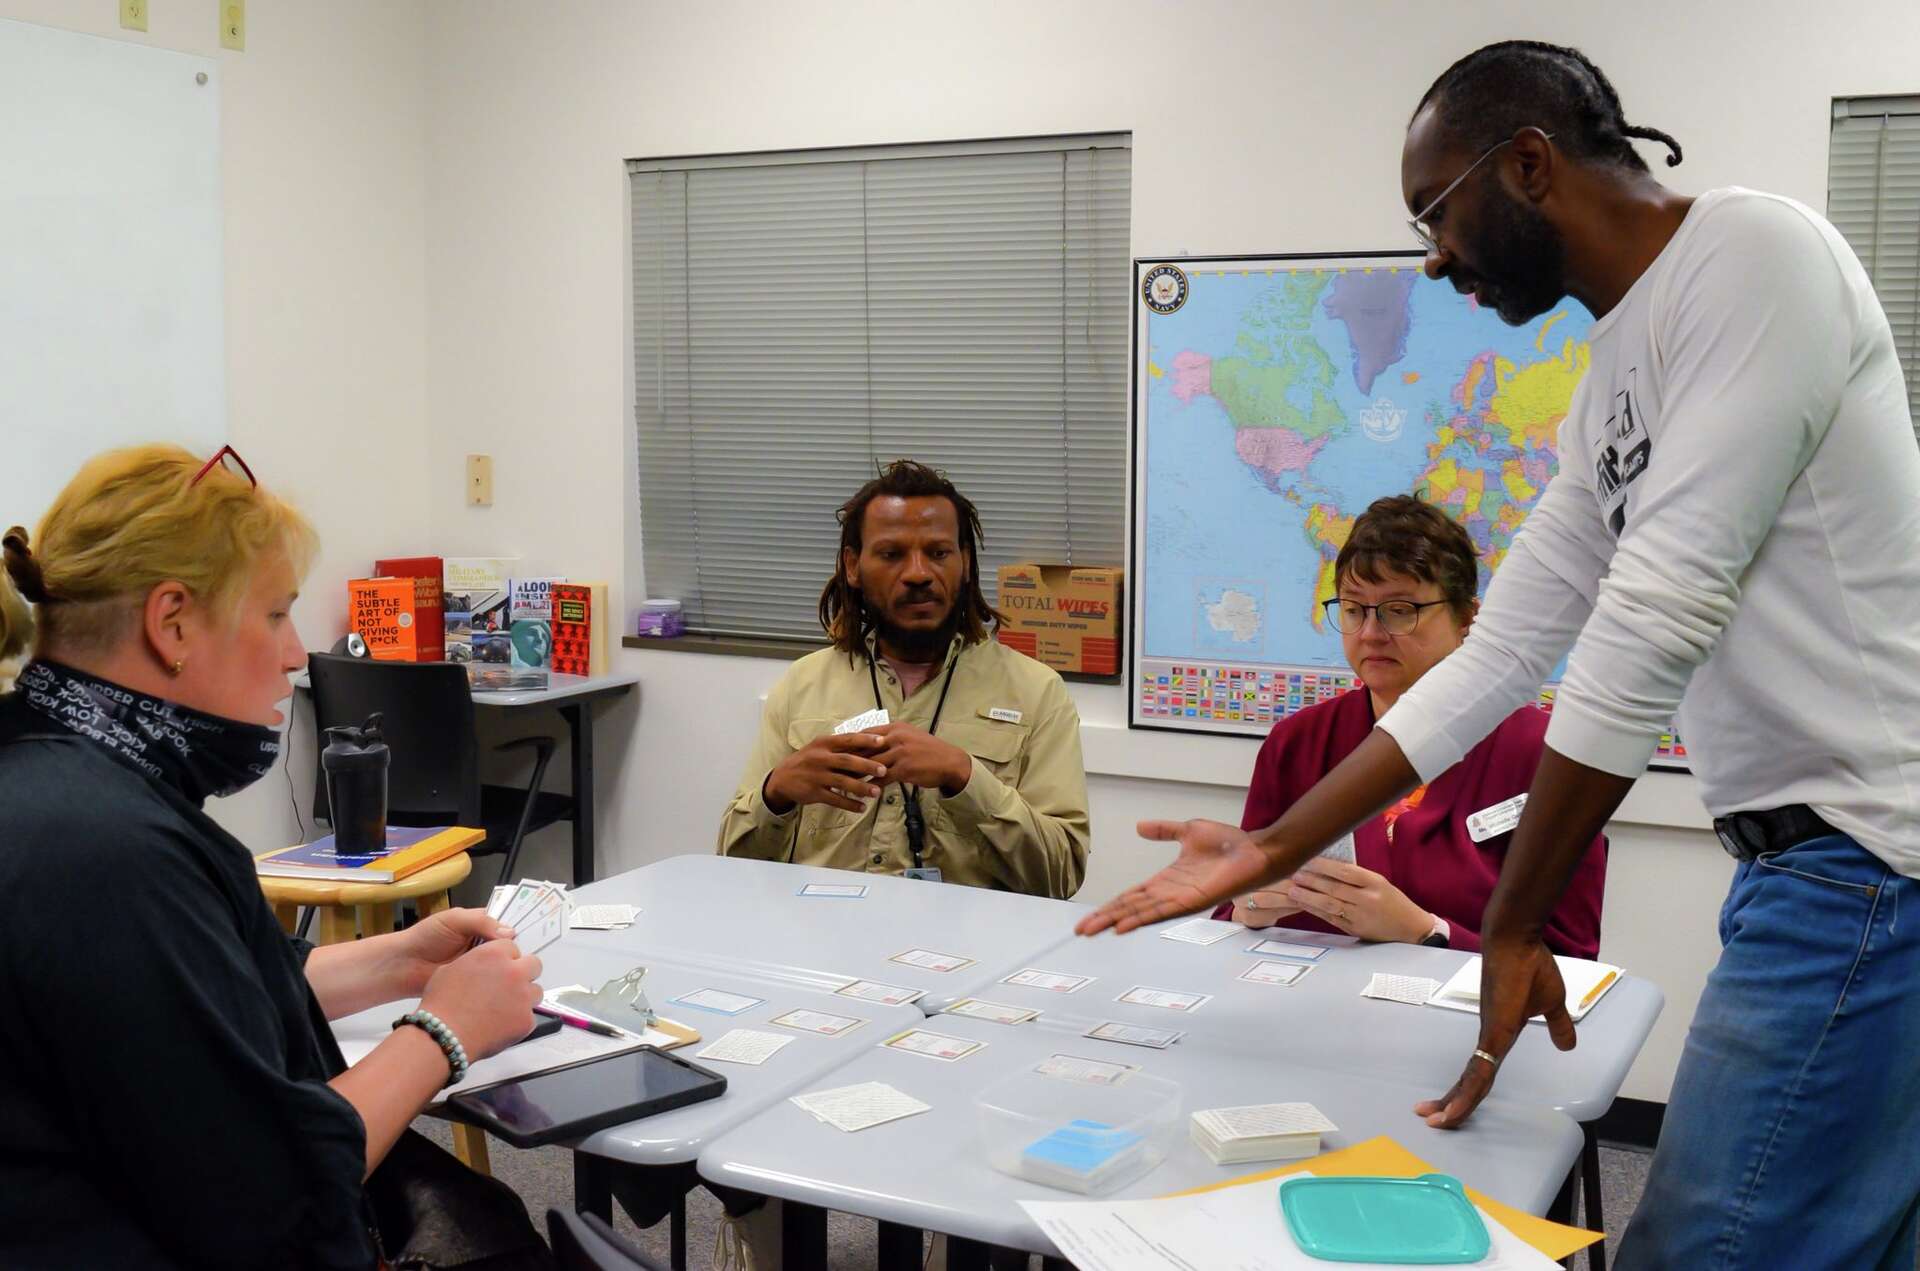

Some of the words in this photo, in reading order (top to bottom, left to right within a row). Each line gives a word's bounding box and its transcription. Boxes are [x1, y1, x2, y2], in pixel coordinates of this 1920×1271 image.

[1154, 302, 1177, 312] NAVY
[356, 589, 379, 598] THE
[357, 598, 400, 609] SUBTLE
[1002, 594, 1055, 611] TOTAL
[1057, 598, 1109, 614] WIPES
[357, 608, 381, 618] ART
[384, 607, 400, 616] OF
[358, 618, 381, 627] NOT
[358, 626, 398, 637] GIVING
[60, 704, 101, 726] LOW
[139, 700, 173, 719] CUT
[106, 722, 147, 753] KICK
